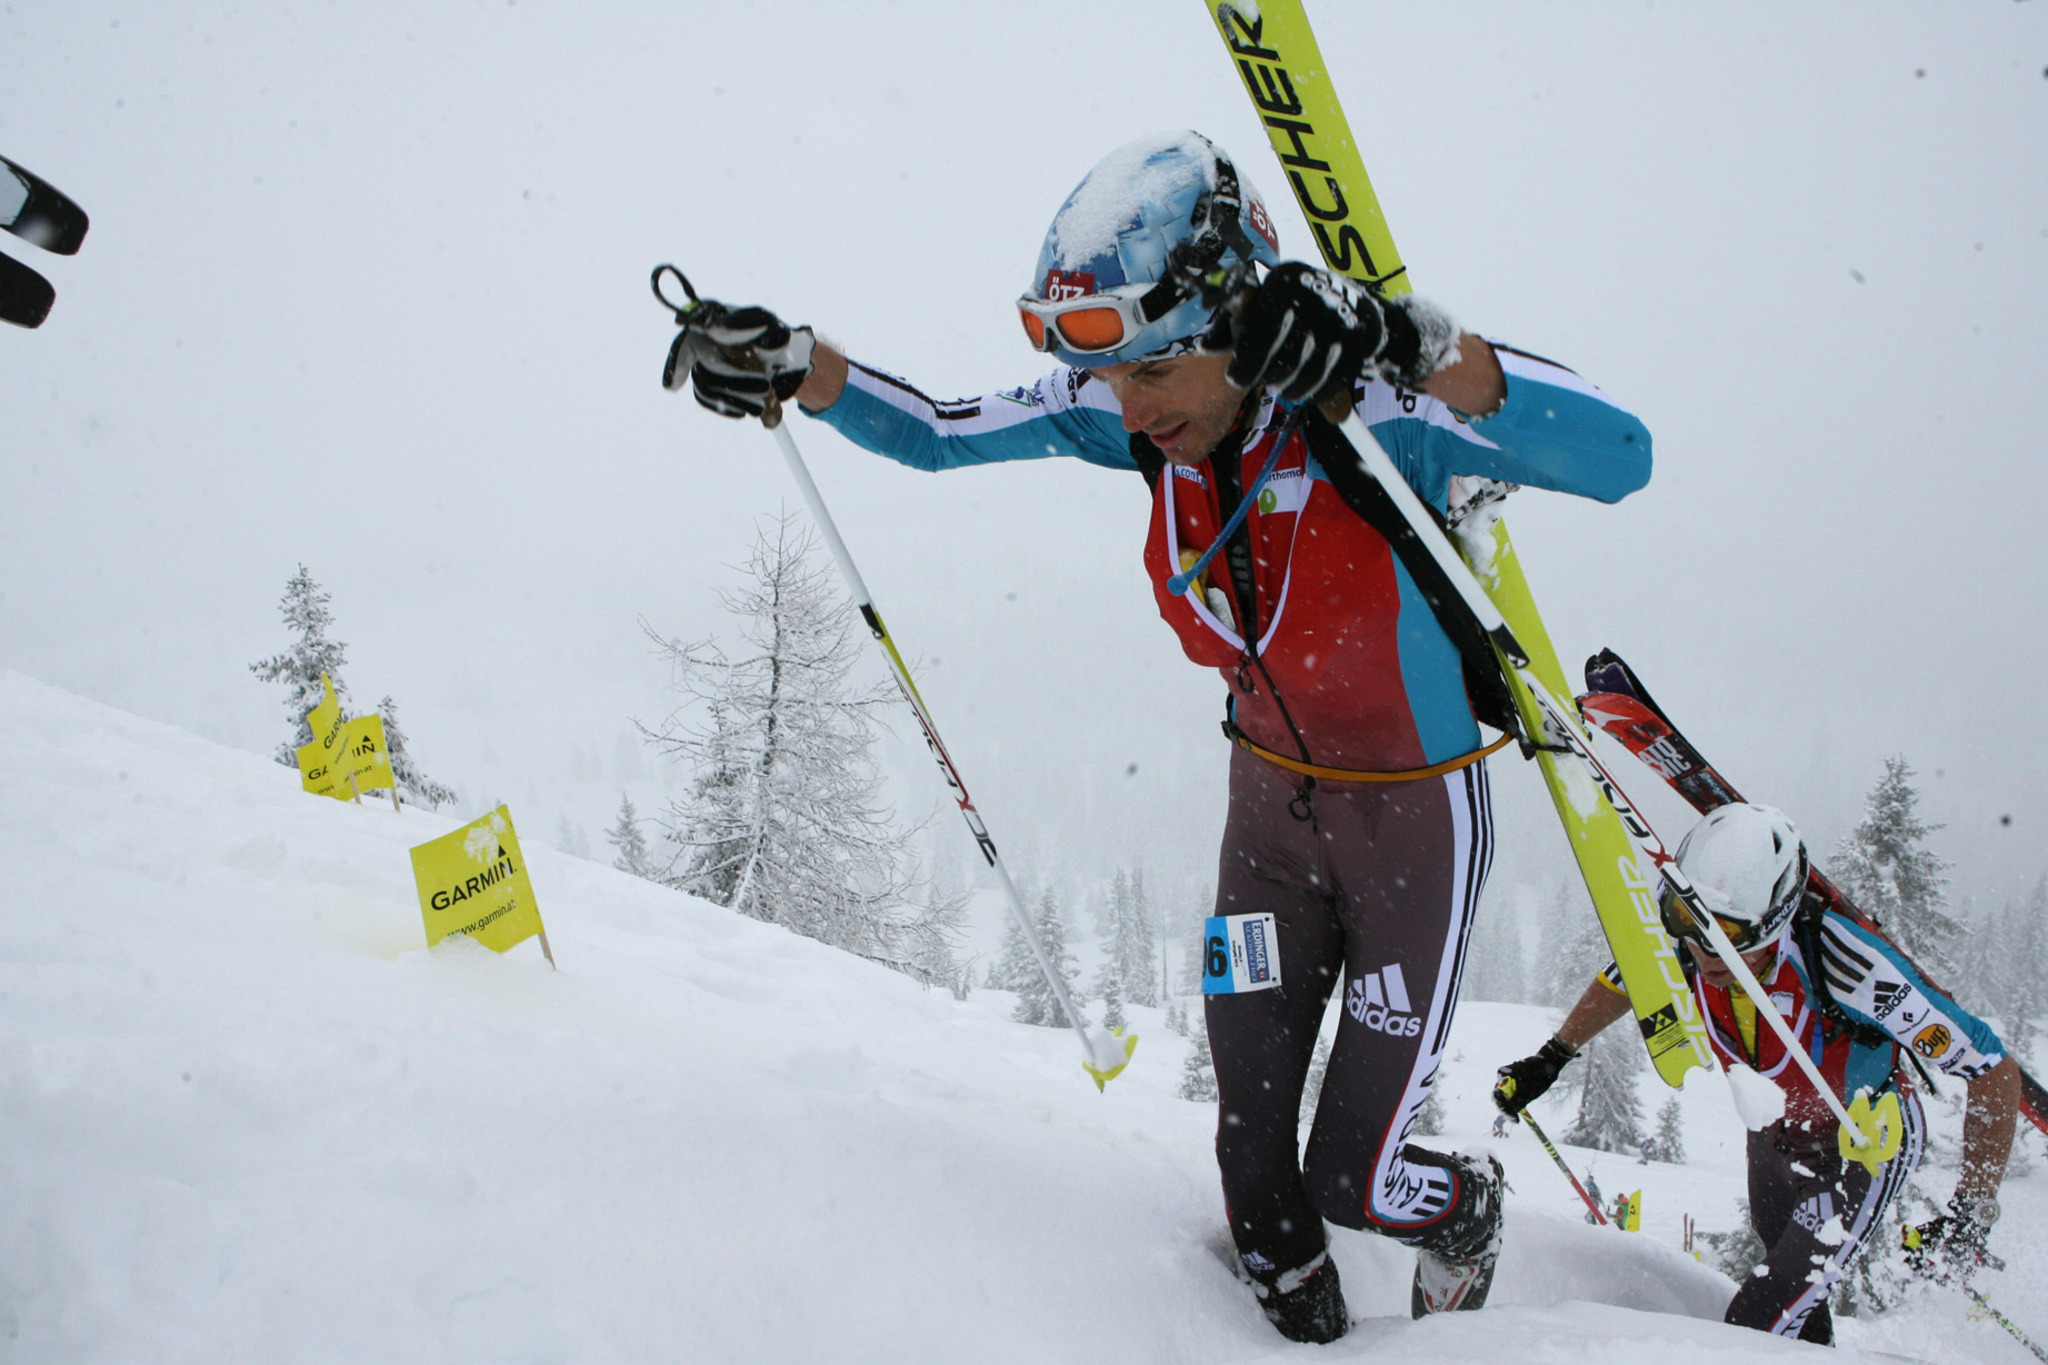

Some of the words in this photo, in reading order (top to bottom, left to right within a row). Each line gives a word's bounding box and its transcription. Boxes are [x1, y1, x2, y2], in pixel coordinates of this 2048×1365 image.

[1217, 3, 1380, 279] SCHER
[430, 856, 515, 911] GARMIN
[1203, 936, 1228, 978] 6
[1251, 921, 1267, 971] ERDINGER
[1346, 986, 1422, 1037] adidas
[1875, 982, 1912, 1021] adidas
